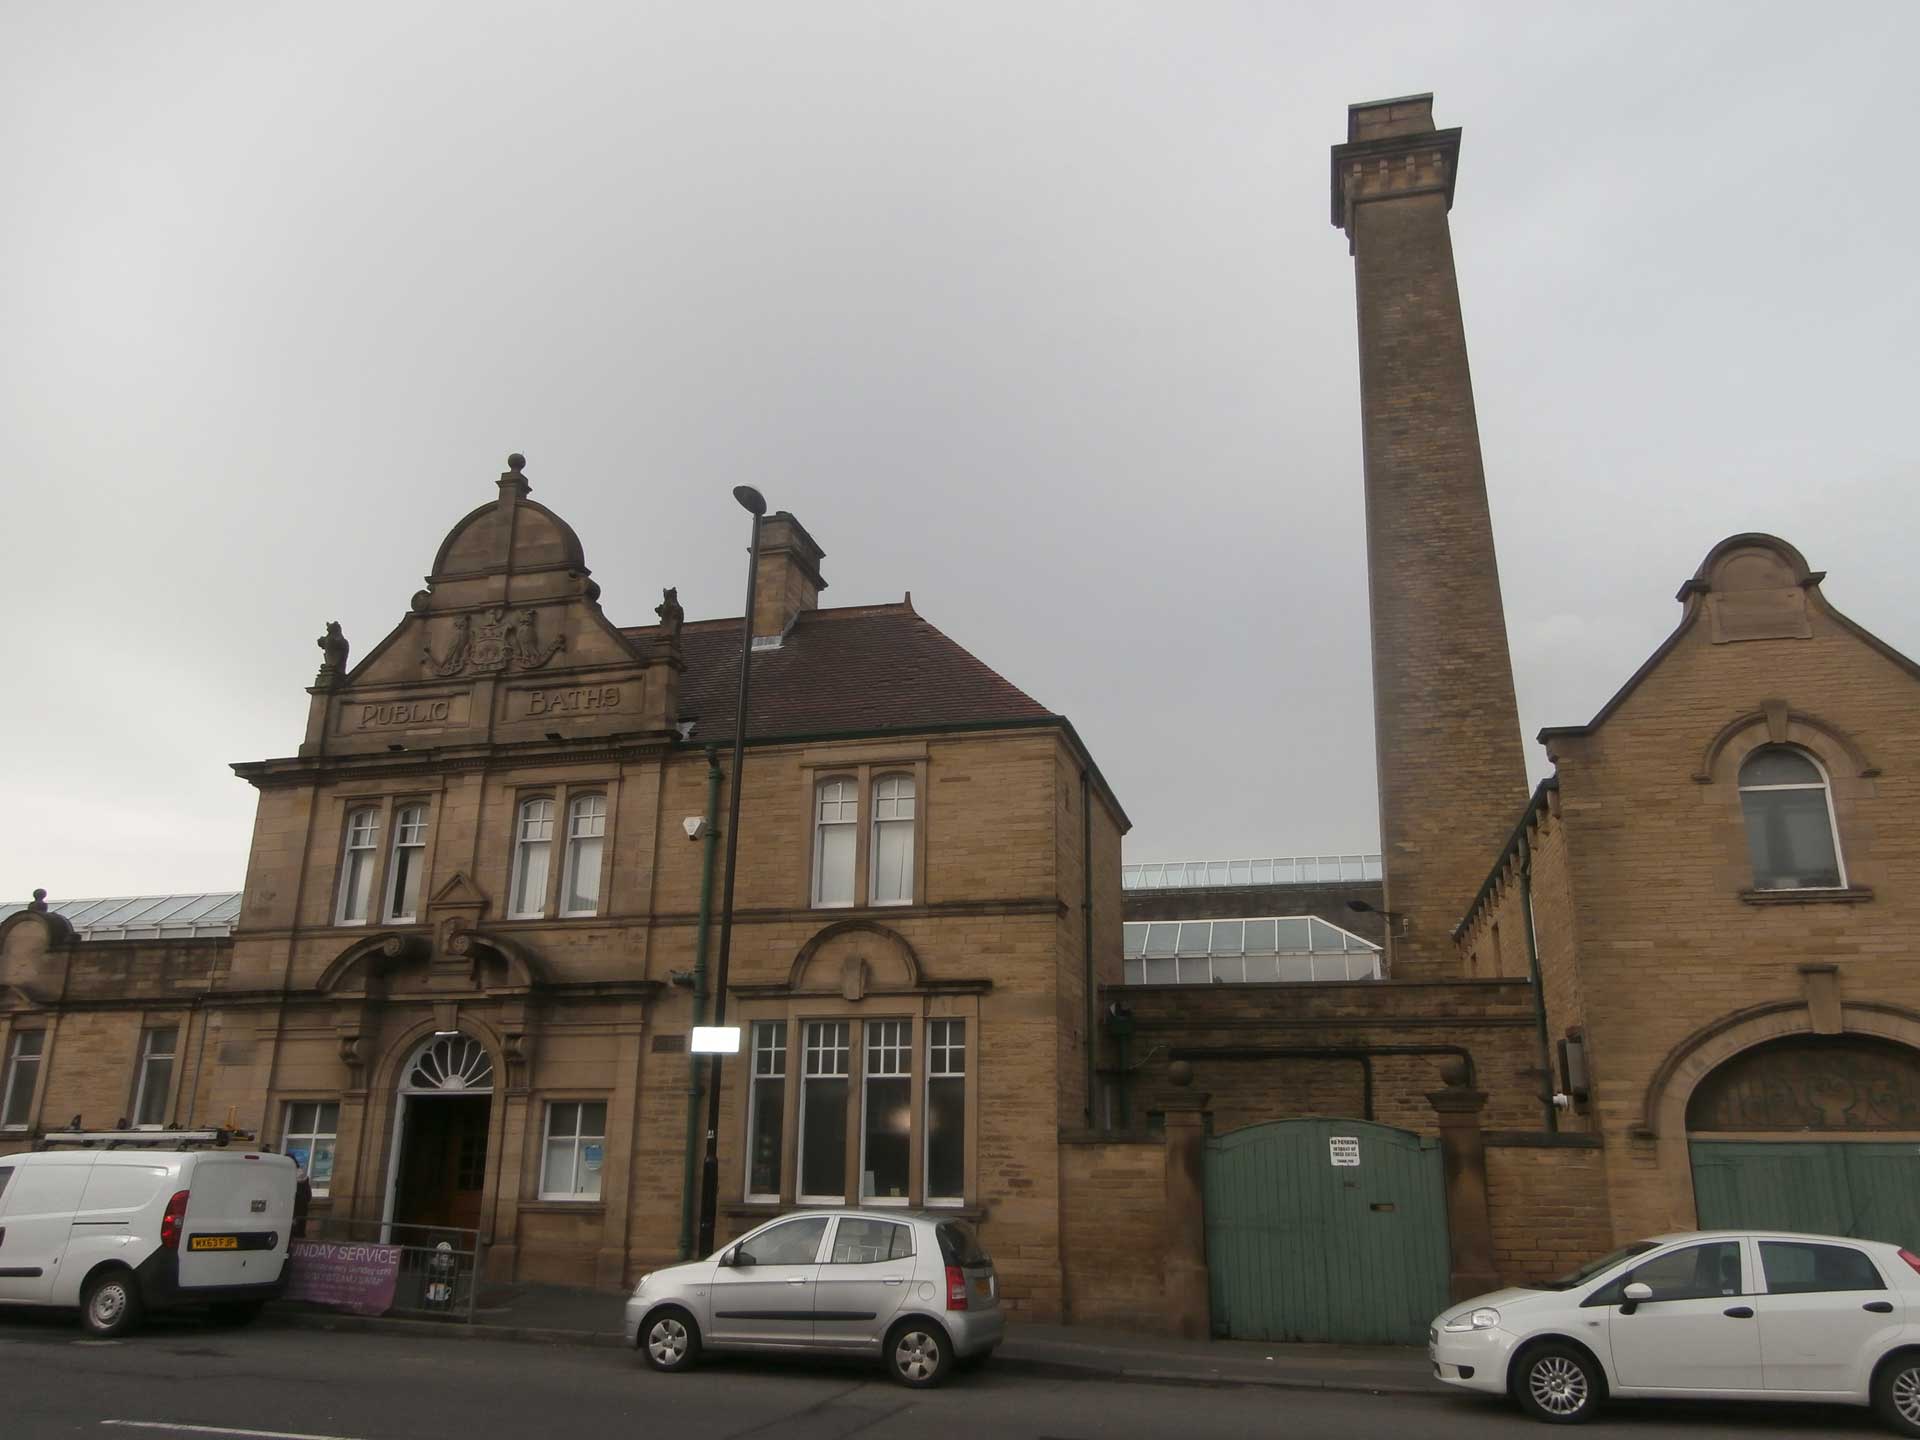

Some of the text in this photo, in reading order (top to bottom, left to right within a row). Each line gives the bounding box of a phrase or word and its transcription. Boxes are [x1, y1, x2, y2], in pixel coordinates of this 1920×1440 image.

[525, 687, 620, 716] BATHS
[357, 702, 449, 728] PUBLIC
[337, 1245, 397, 1265] SERVICE
